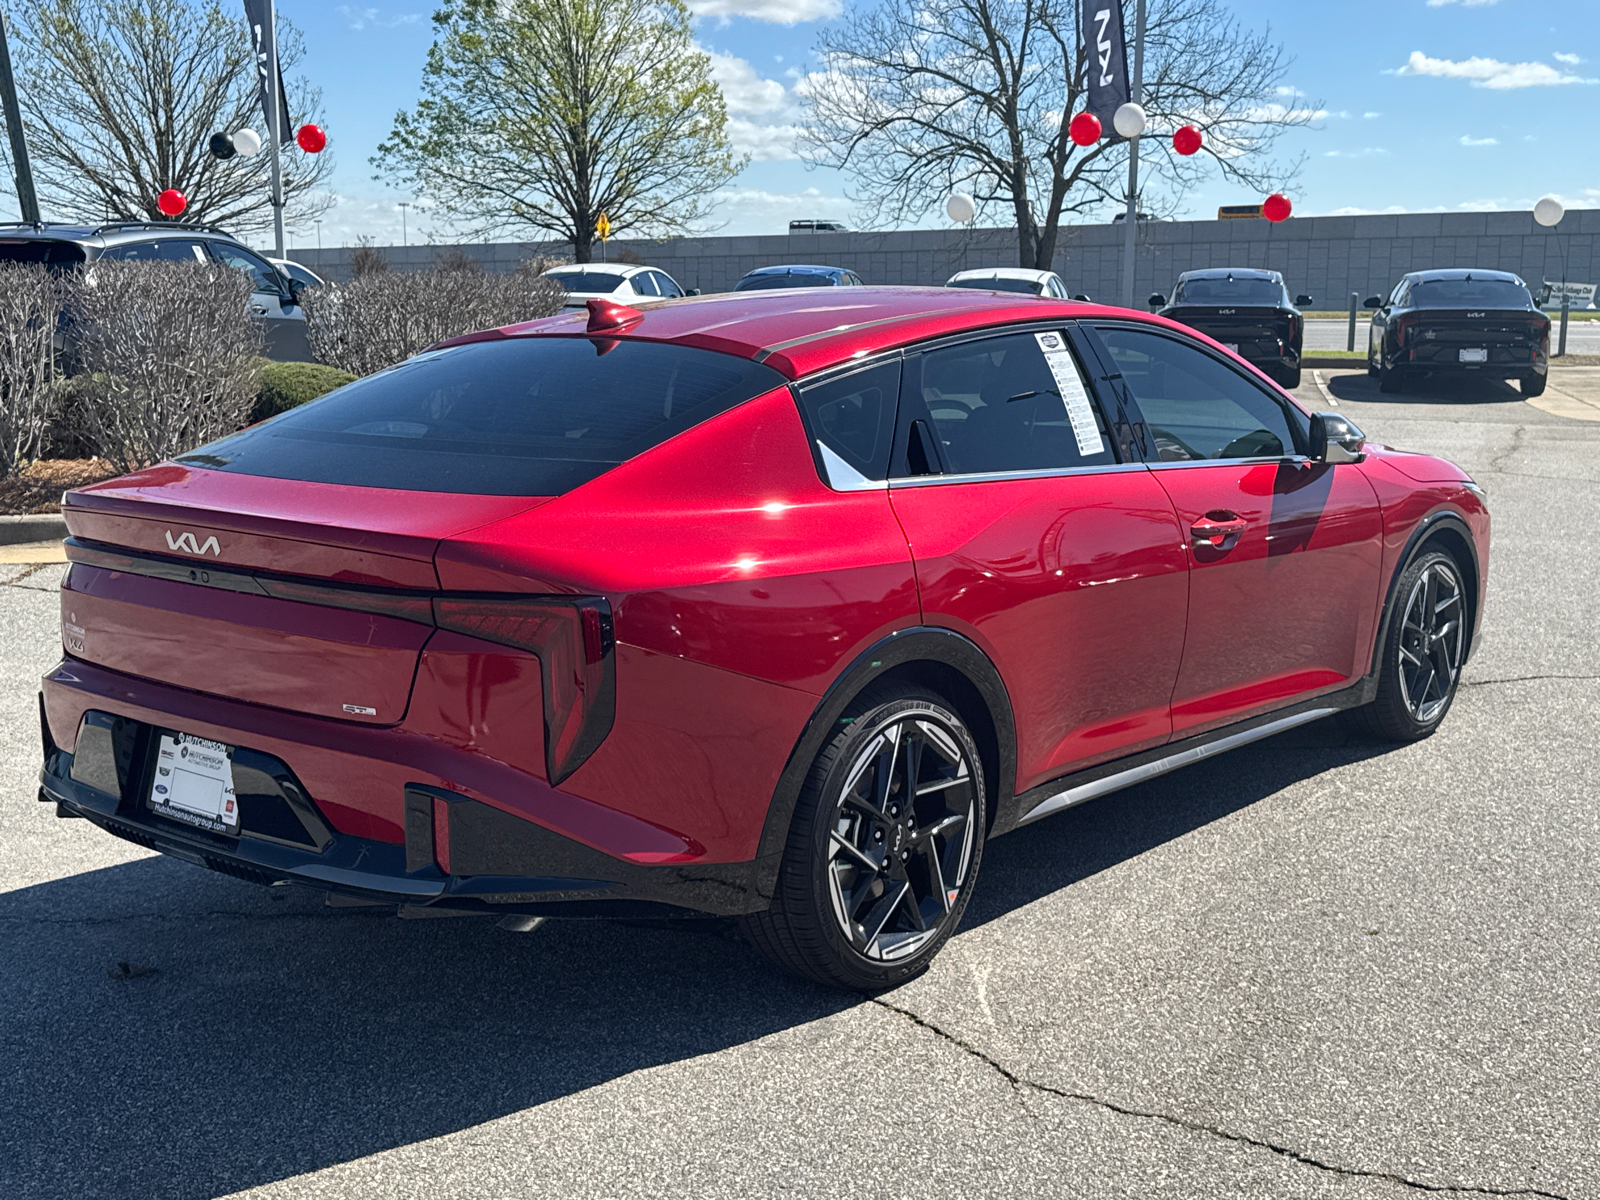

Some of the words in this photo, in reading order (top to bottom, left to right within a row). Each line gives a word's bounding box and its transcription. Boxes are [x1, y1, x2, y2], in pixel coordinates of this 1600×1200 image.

[1094, 8, 1113, 87] KIA
[165, 529, 221, 557] KIA
[68, 637, 85, 653] K4
[186, 734, 227, 753] HUTCHINSON
[188, 750, 224, 766] HUTCHINSON
